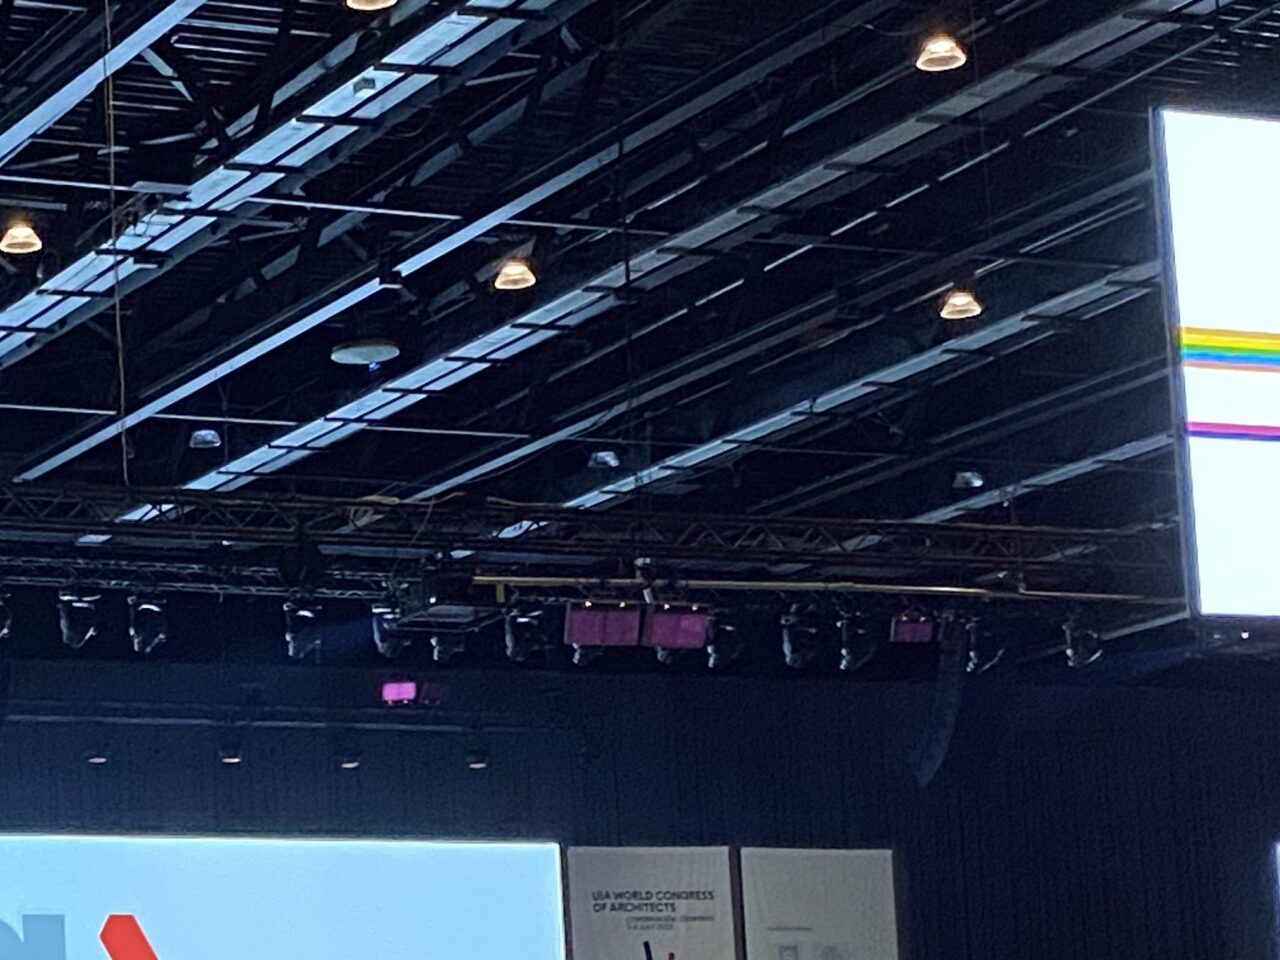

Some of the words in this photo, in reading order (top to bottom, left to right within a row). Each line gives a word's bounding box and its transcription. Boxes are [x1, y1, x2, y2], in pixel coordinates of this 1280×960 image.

[612, 890, 654, 901] WORLD
[655, 890, 714, 901] CONGRESS
[592, 902, 606, 912] OF
[609, 902, 676, 913] ARCHITECTS
